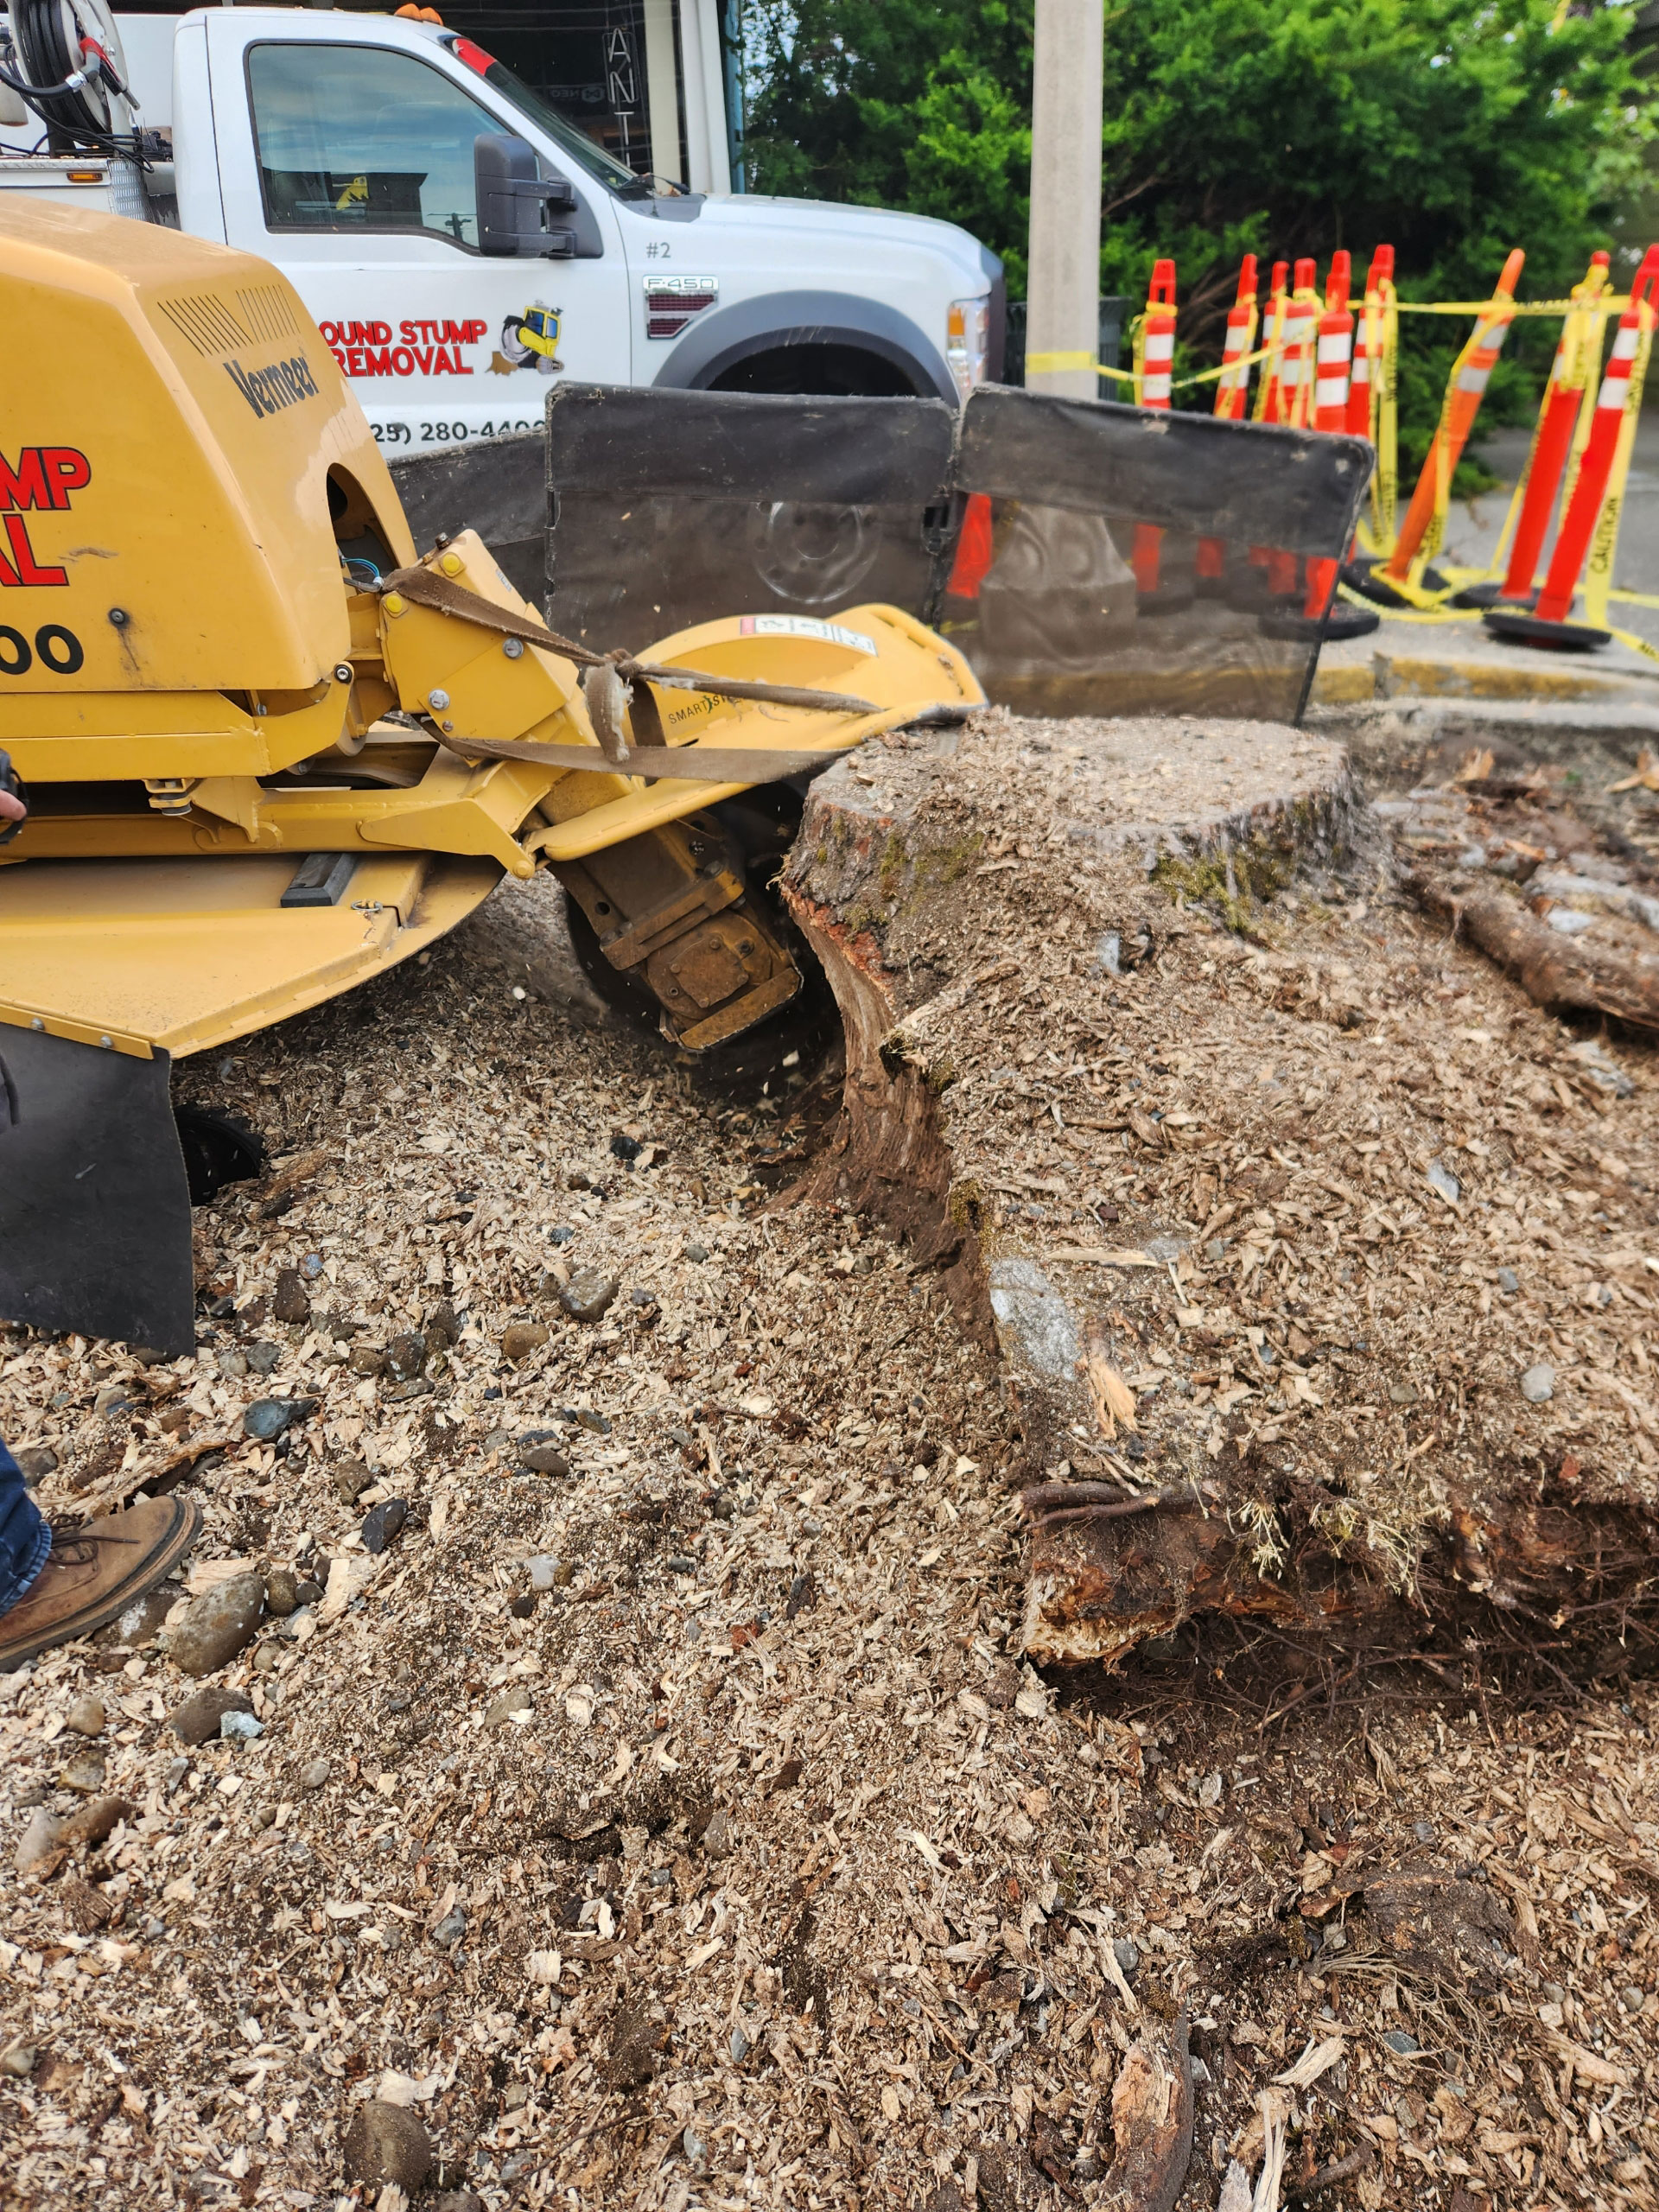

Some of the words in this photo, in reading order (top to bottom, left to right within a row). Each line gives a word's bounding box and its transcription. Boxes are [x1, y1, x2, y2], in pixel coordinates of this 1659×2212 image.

[646, 242, 671, 258] #2
[319, 321, 392, 346] OUND
[399, 320, 487, 346] STUMP
[223, 356, 319, 418] Vermeer
